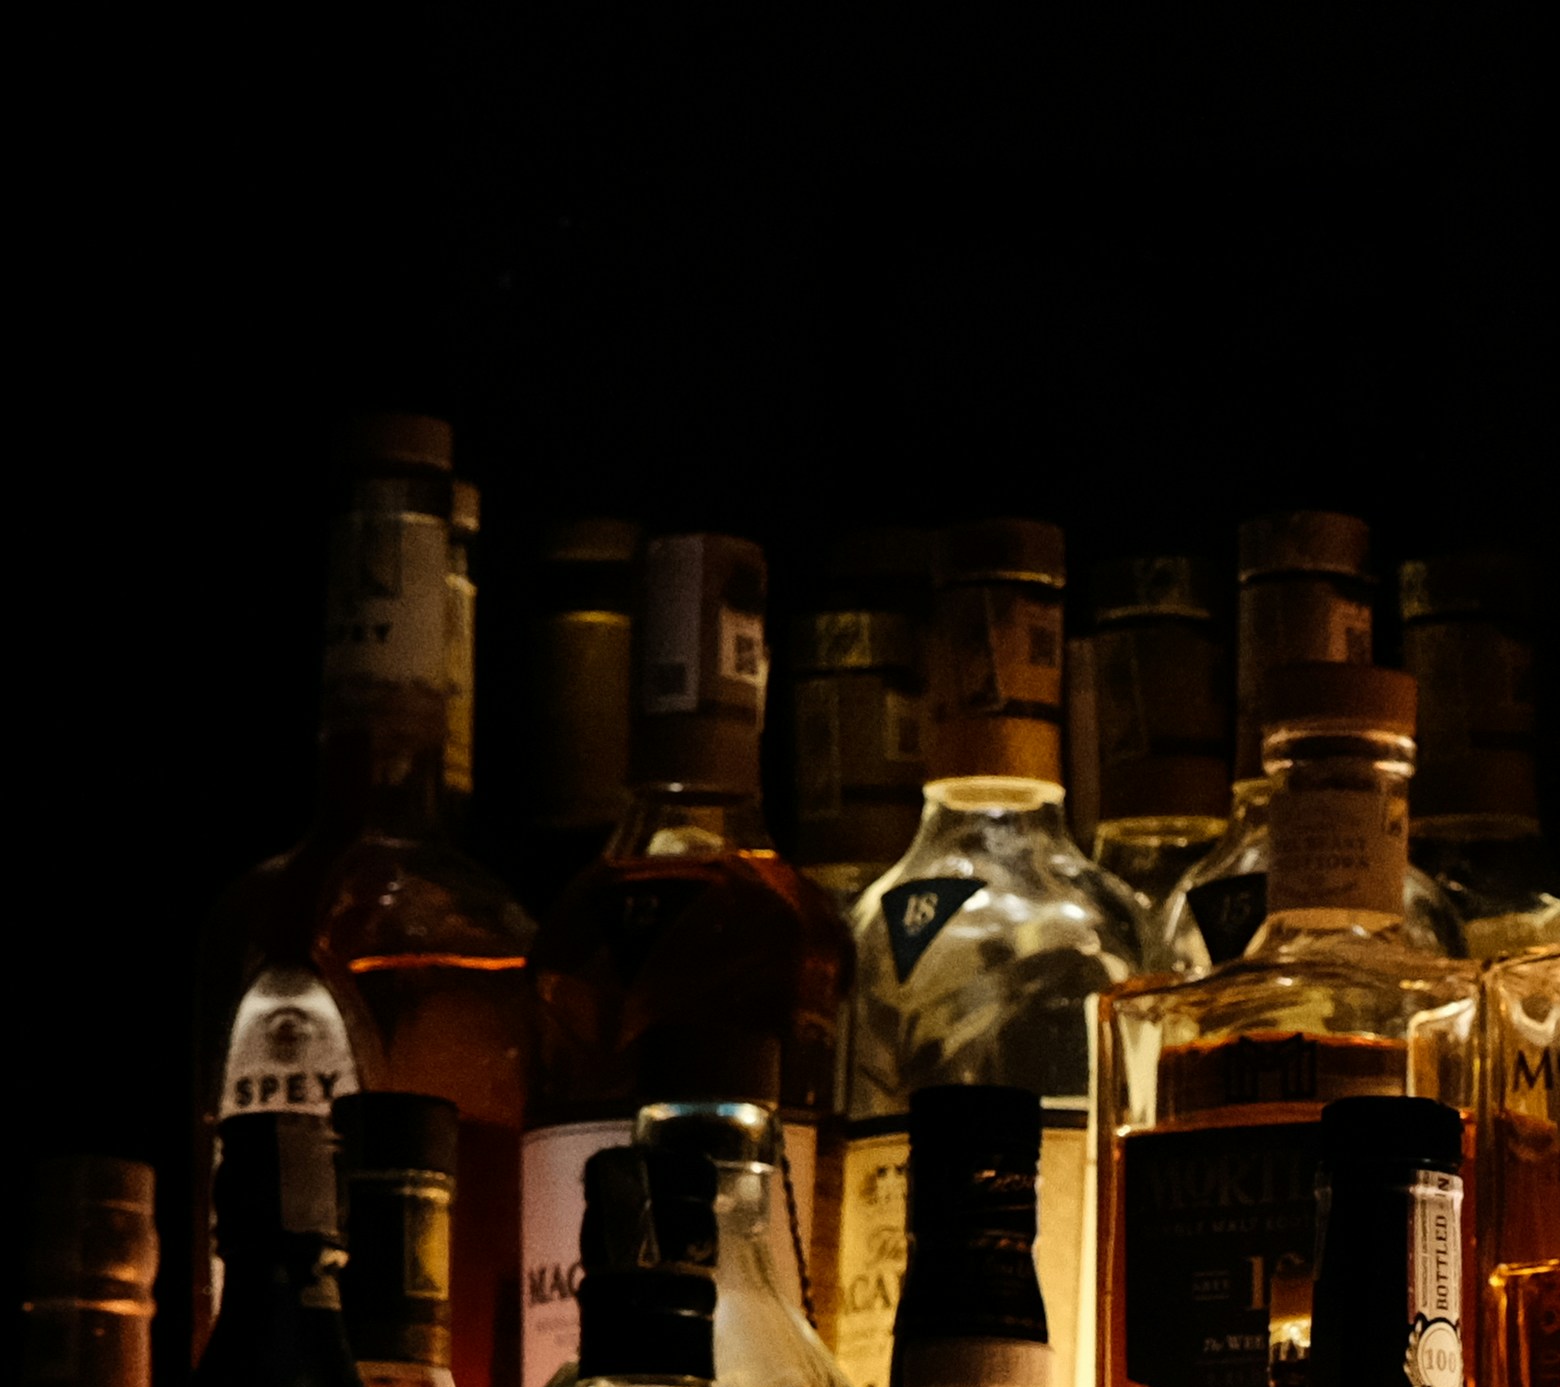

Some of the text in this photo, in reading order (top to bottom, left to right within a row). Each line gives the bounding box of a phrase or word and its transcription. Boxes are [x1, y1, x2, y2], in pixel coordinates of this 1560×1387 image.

[234, 1076, 337, 1105] SPEY
[1436, 1214, 1448, 1311] BOTTLED
[528, 1263, 586, 1304] MAC
